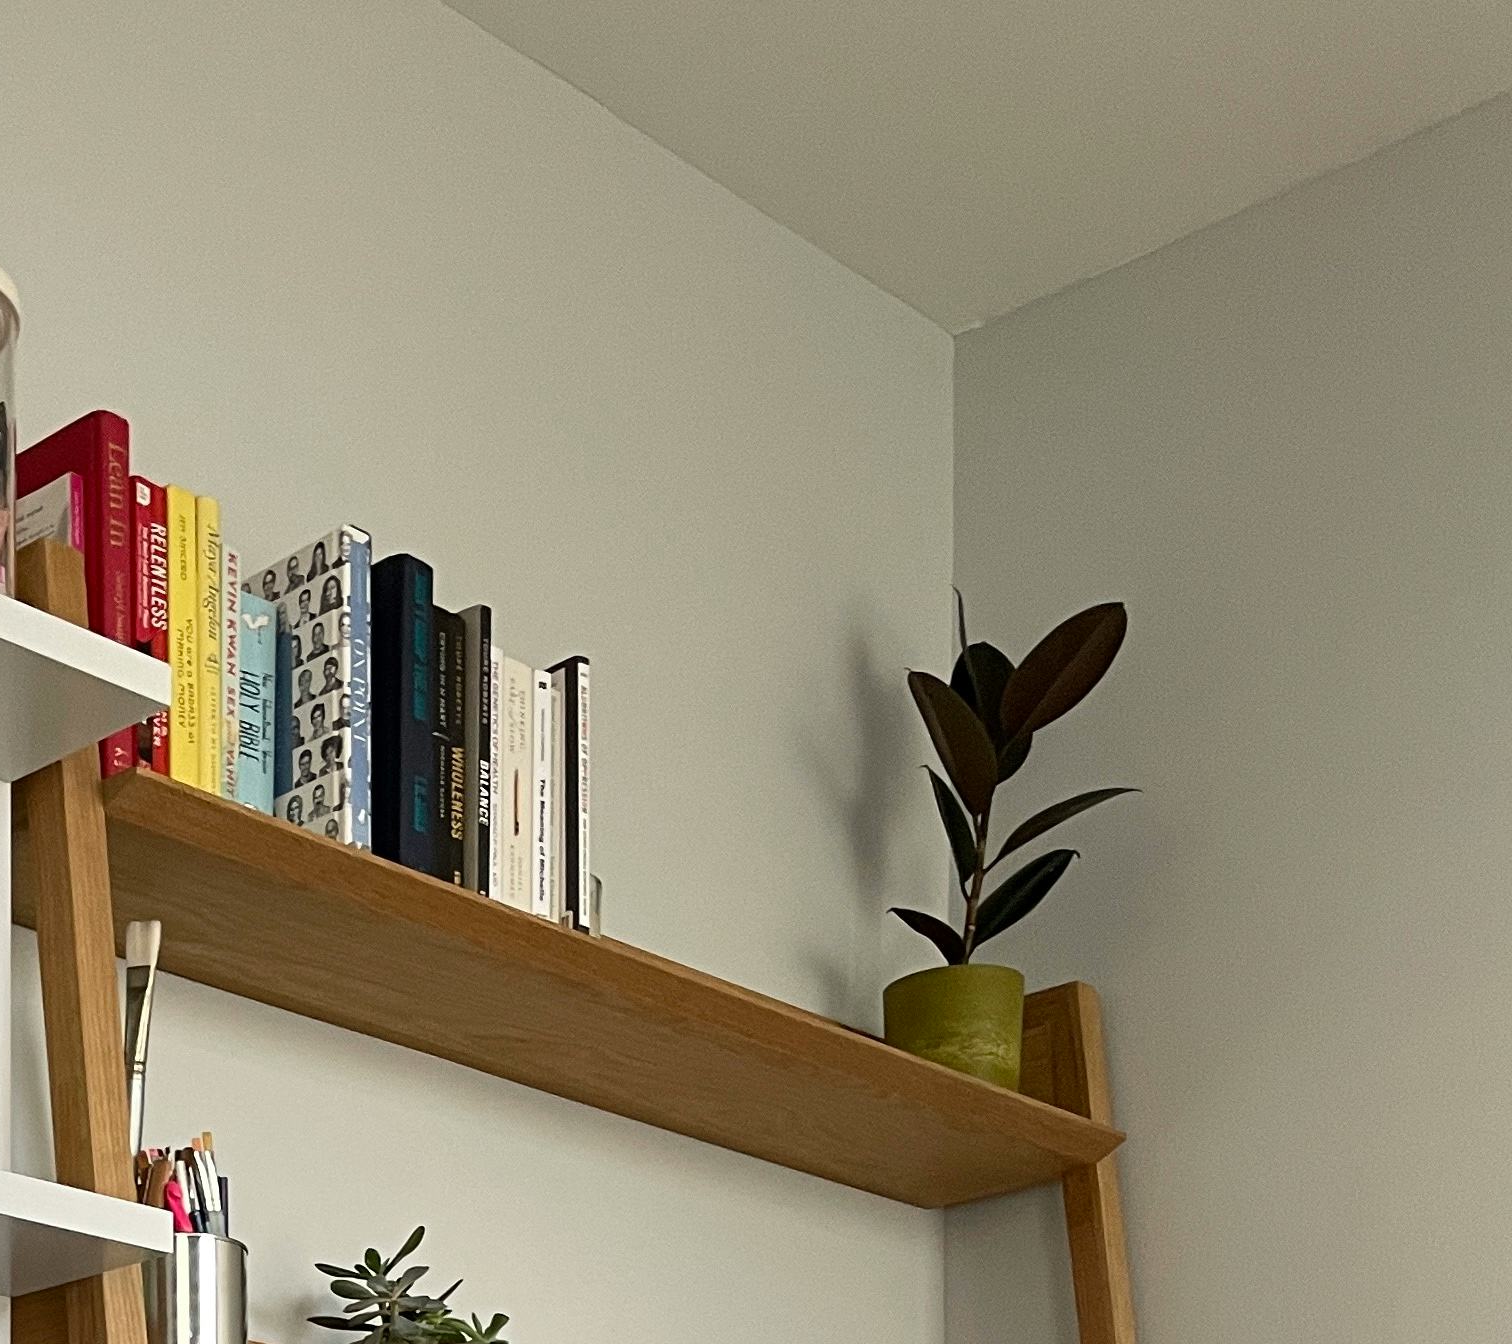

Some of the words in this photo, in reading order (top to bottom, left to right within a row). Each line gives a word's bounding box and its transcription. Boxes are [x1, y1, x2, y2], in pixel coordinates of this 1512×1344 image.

[109, 442, 126, 509] Lean
[110, 518, 125, 547] In
[202, 524, 220, 574] Maya
[151, 523, 166, 630] RELENTLESS
[228, 553, 238, 613] KEVIN
[176, 628, 185, 678] MAKING
[227, 618, 237, 676] KWAN
[353, 638, 366, 668] ON
[227, 687, 236, 716] SEX
[239, 670, 261, 713] HOLY
[262, 673, 273, 687] New
[178, 684, 186, 728] MONEY
[353, 676, 366, 748] POINT
[239, 720, 260, 762] BIBLE
[492, 736, 499, 752] OF
[226, 749, 236, 799] VANIT
[451, 747, 464, 840] WHOLENESS
[479, 760, 489, 826] BALANCE
[539, 846, 546, 857] of
